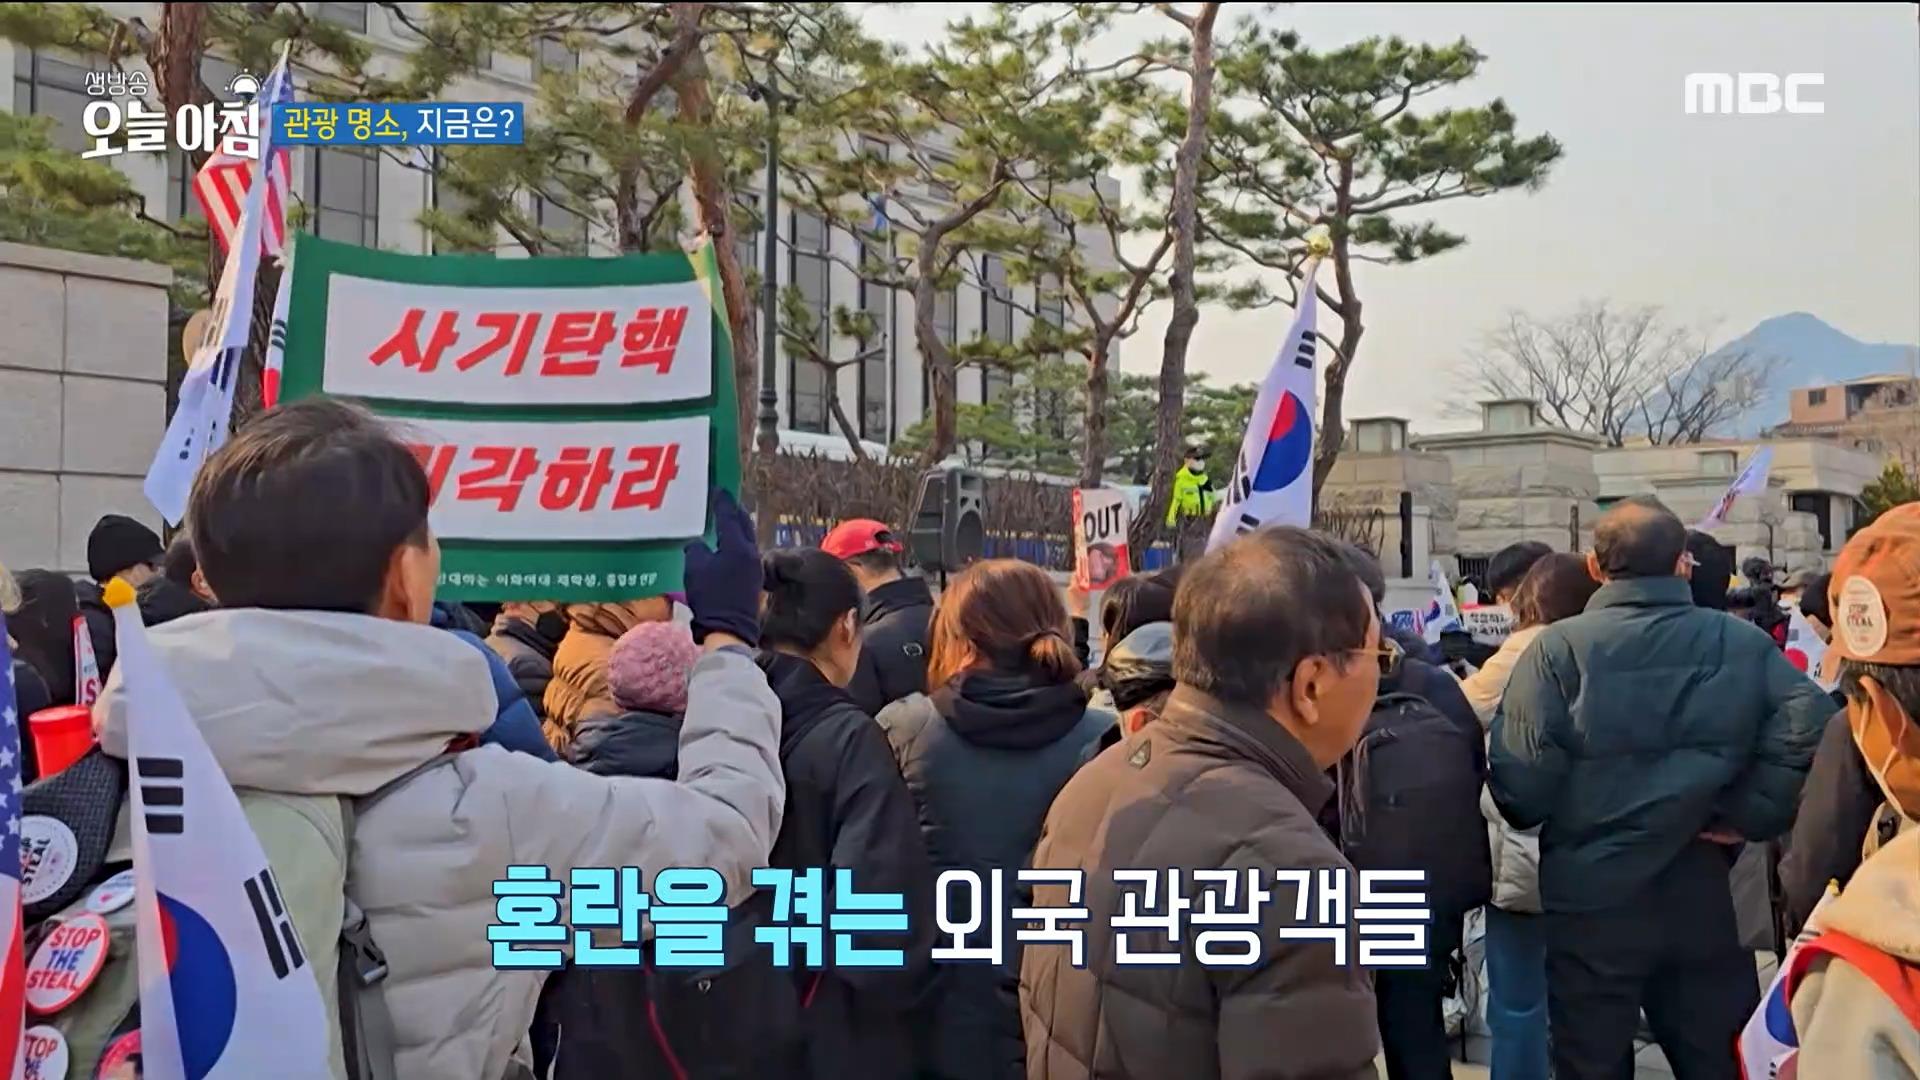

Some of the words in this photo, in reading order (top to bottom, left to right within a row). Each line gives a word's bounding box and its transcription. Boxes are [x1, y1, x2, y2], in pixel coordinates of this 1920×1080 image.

[368, 306, 689, 377] 사기탄핵
[1083, 502, 1122, 543] OUT
[50, 926, 101, 949] STOP
[46, 949, 84, 971] THE
[26, 970, 80, 991] STEAL
[25, 1034, 59, 1058] TOP
